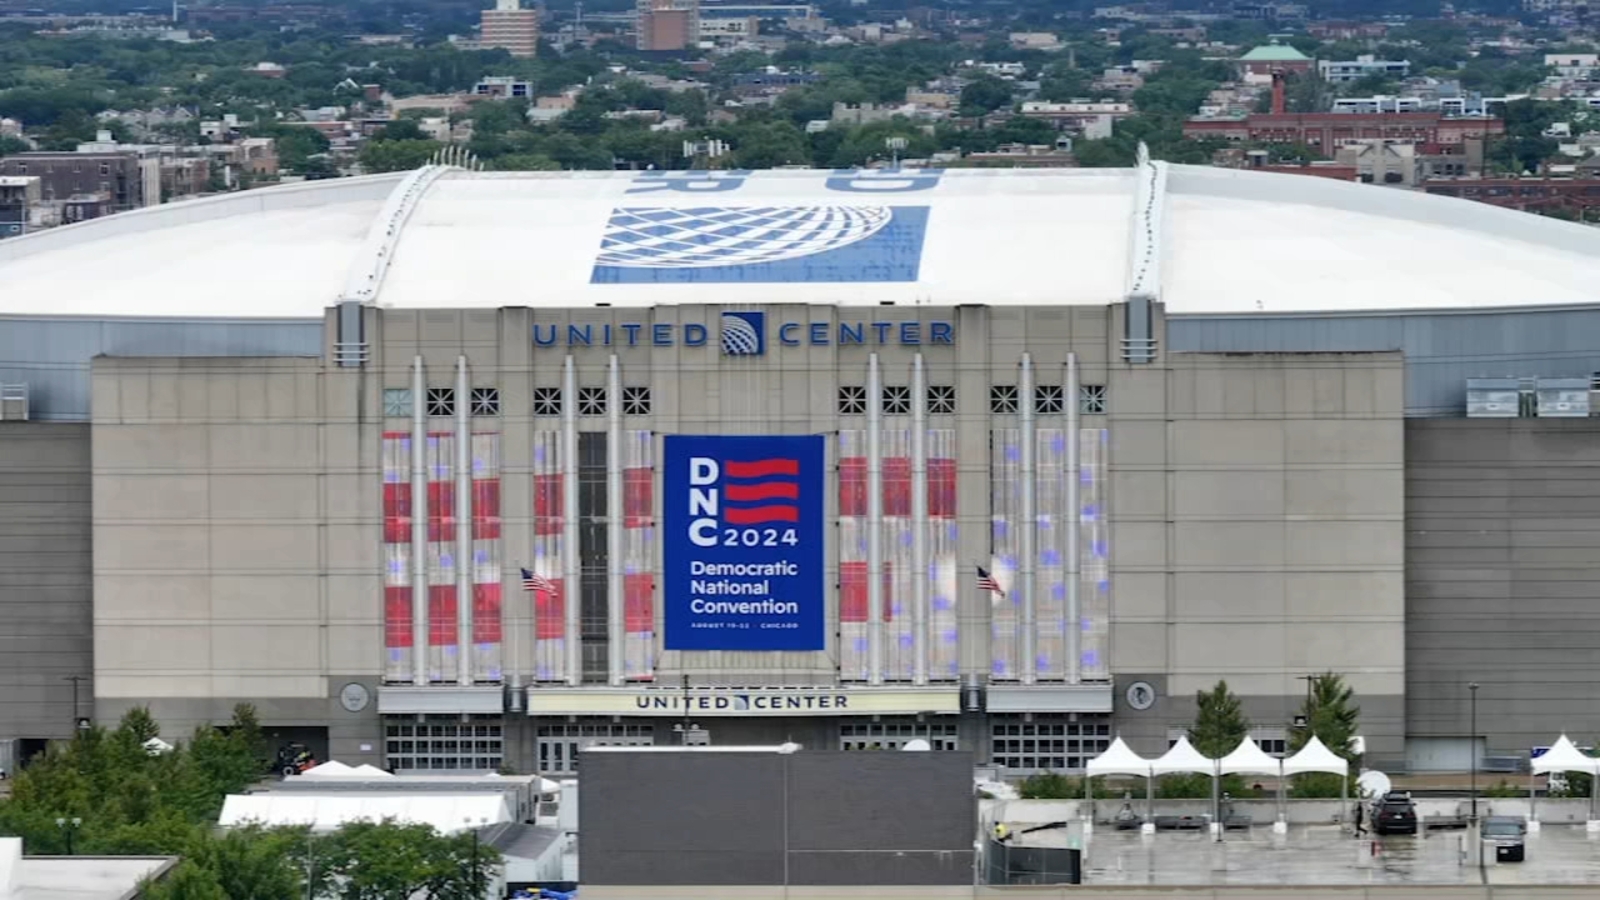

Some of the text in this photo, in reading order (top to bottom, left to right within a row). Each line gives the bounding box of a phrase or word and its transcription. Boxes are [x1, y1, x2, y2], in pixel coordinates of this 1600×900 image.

[533, 322, 954, 347] UNITED CENTER
[723, 528, 799, 547] 2024
[690, 560, 798, 576] Democratic
[690, 579, 770, 595] National
[690, 598, 798, 614] Convention
[636, 694, 849, 710] UNITED CENTER
